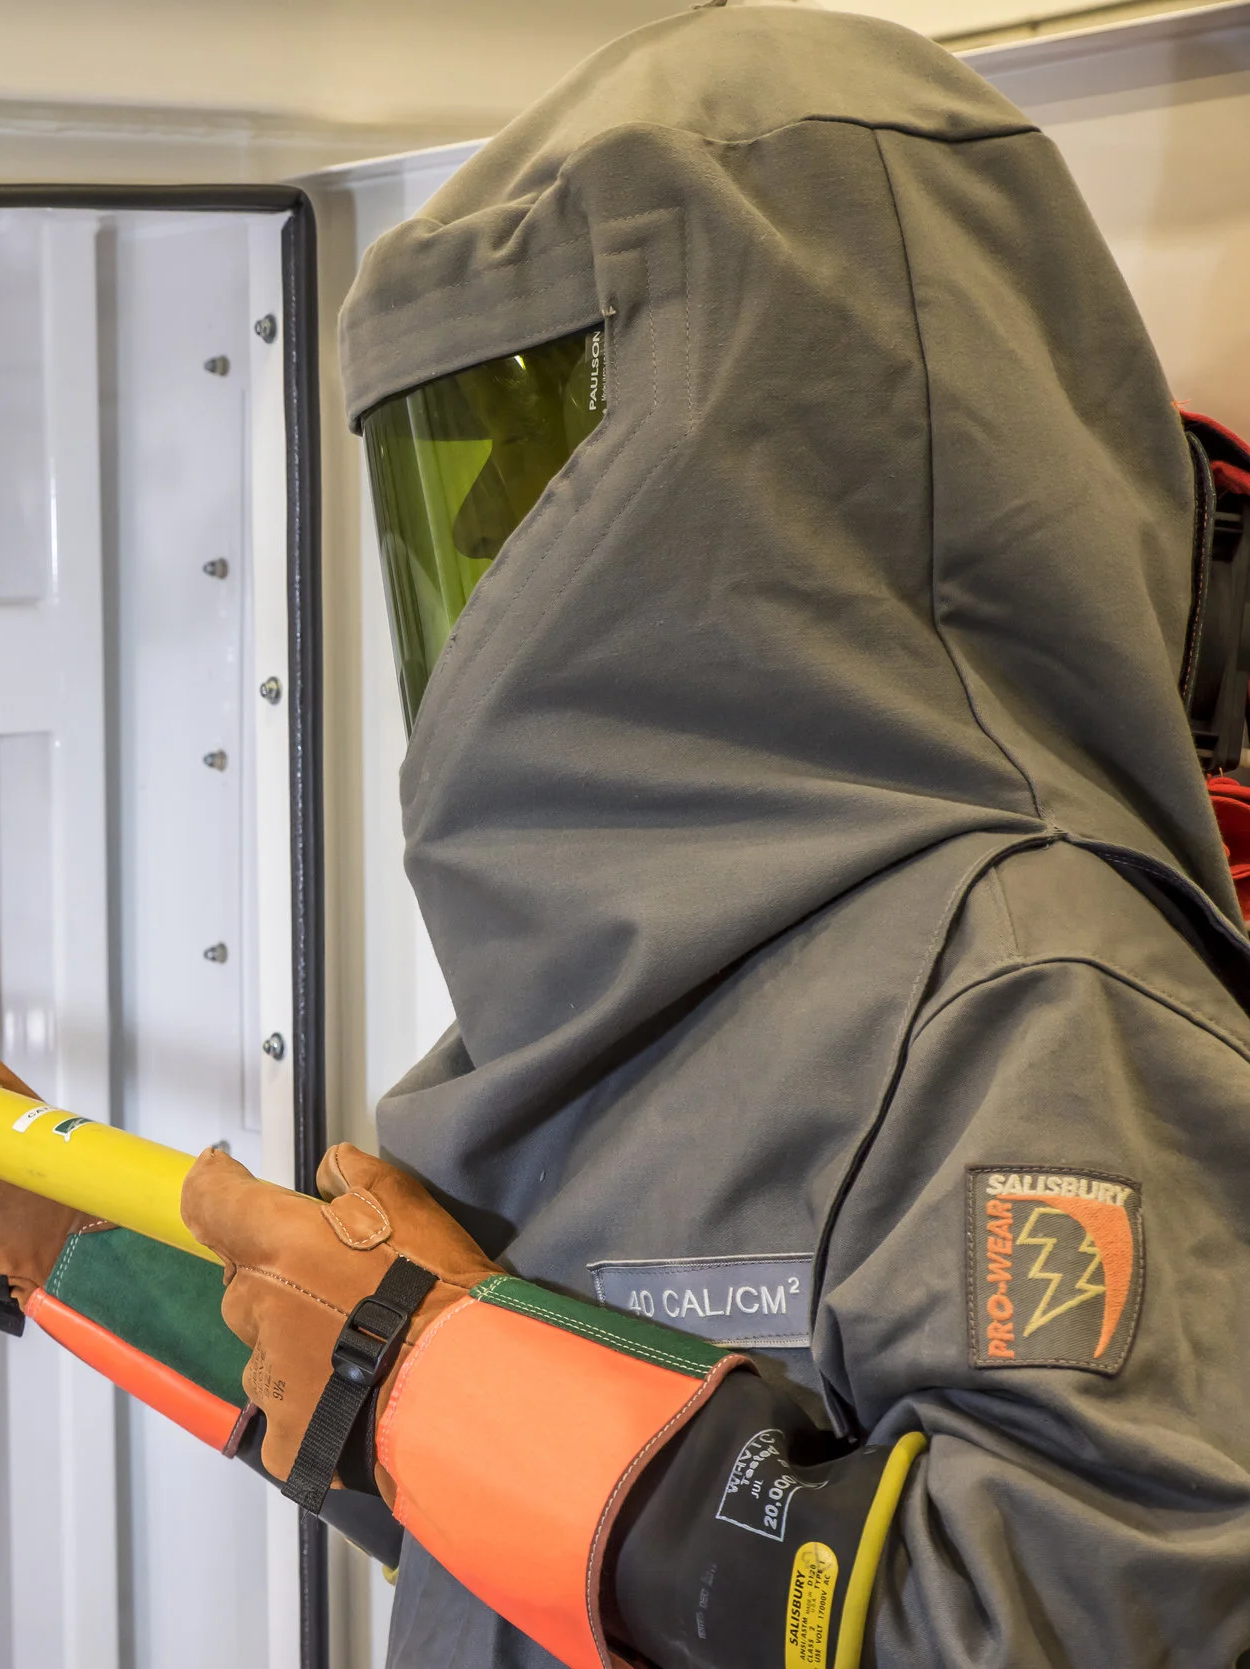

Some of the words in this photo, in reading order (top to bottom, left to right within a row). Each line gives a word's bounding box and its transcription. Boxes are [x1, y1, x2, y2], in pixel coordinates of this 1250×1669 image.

[589, 331, 601, 410] PAULSON
[985, 1173, 1134, 1207] SALISBURY
[985, 1199, 1015, 1359] PRO-WEAR
[628, 1290, 654, 1318] 40
[751, 1480, 765, 1499] JUL
[764, 1475, 797, 1530] 20,000
[824, 1574, 831, 1586] AC
[789, 1570, 806, 1646] SALISBURY
[799, 1617, 808, 1661] ANSI/ASTM
[807, 1564, 816, 1586] D120
[807, 1639, 815, 1663] CLASS
[814, 1569, 823, 1589] TYPE
[817, 1590, 828, 1619] 17000V
[815, 1624, 823, 1644] VOLT
